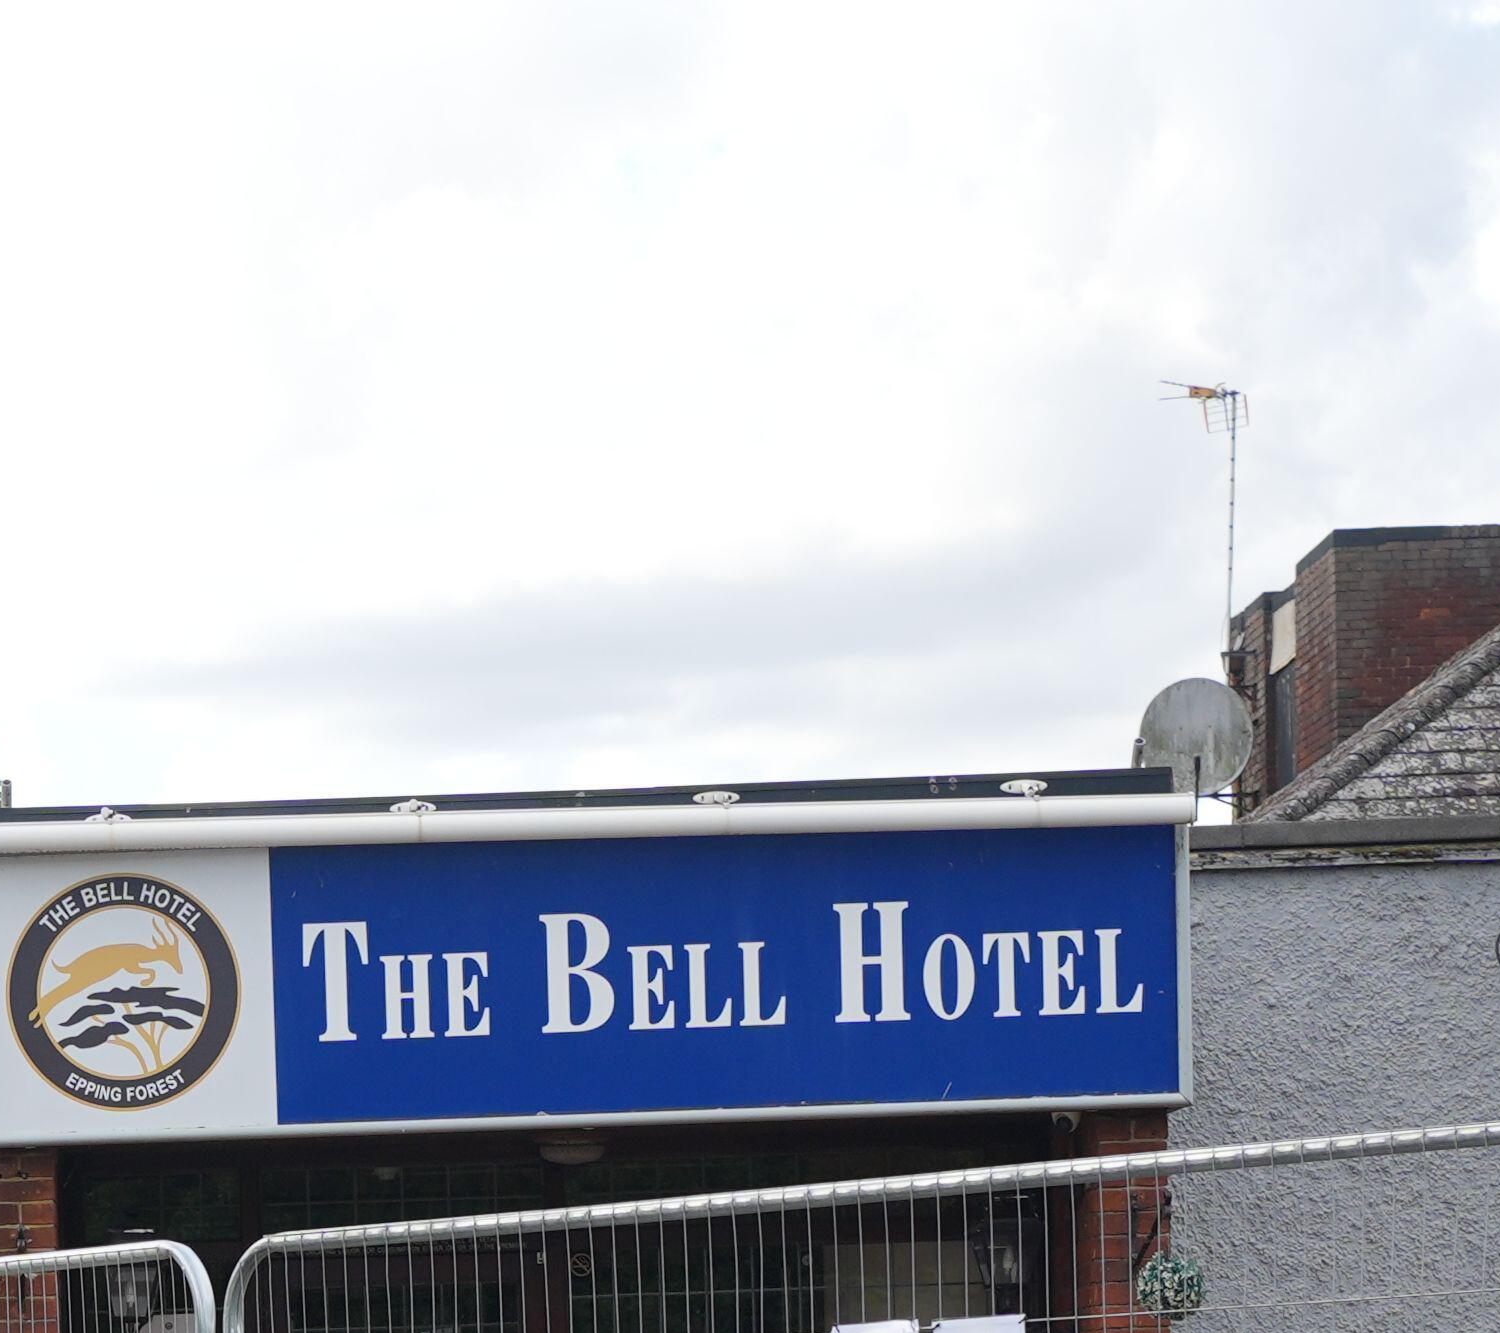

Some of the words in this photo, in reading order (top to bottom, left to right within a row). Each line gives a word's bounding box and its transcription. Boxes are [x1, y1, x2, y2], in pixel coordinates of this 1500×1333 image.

[38, 895, 80, 932] THE
[81, 881, 134, 908] BELL
[140, 883, 202, 932] HOTEL
[302, 921, 490, 1042] THE
[538, 913, 786, 1034] BELL
[832, 901, 1144, 1023] HOTEL
[65, 1072, 121, 1102] EPPING
[127, 1069, 185, 1102] FOREST
